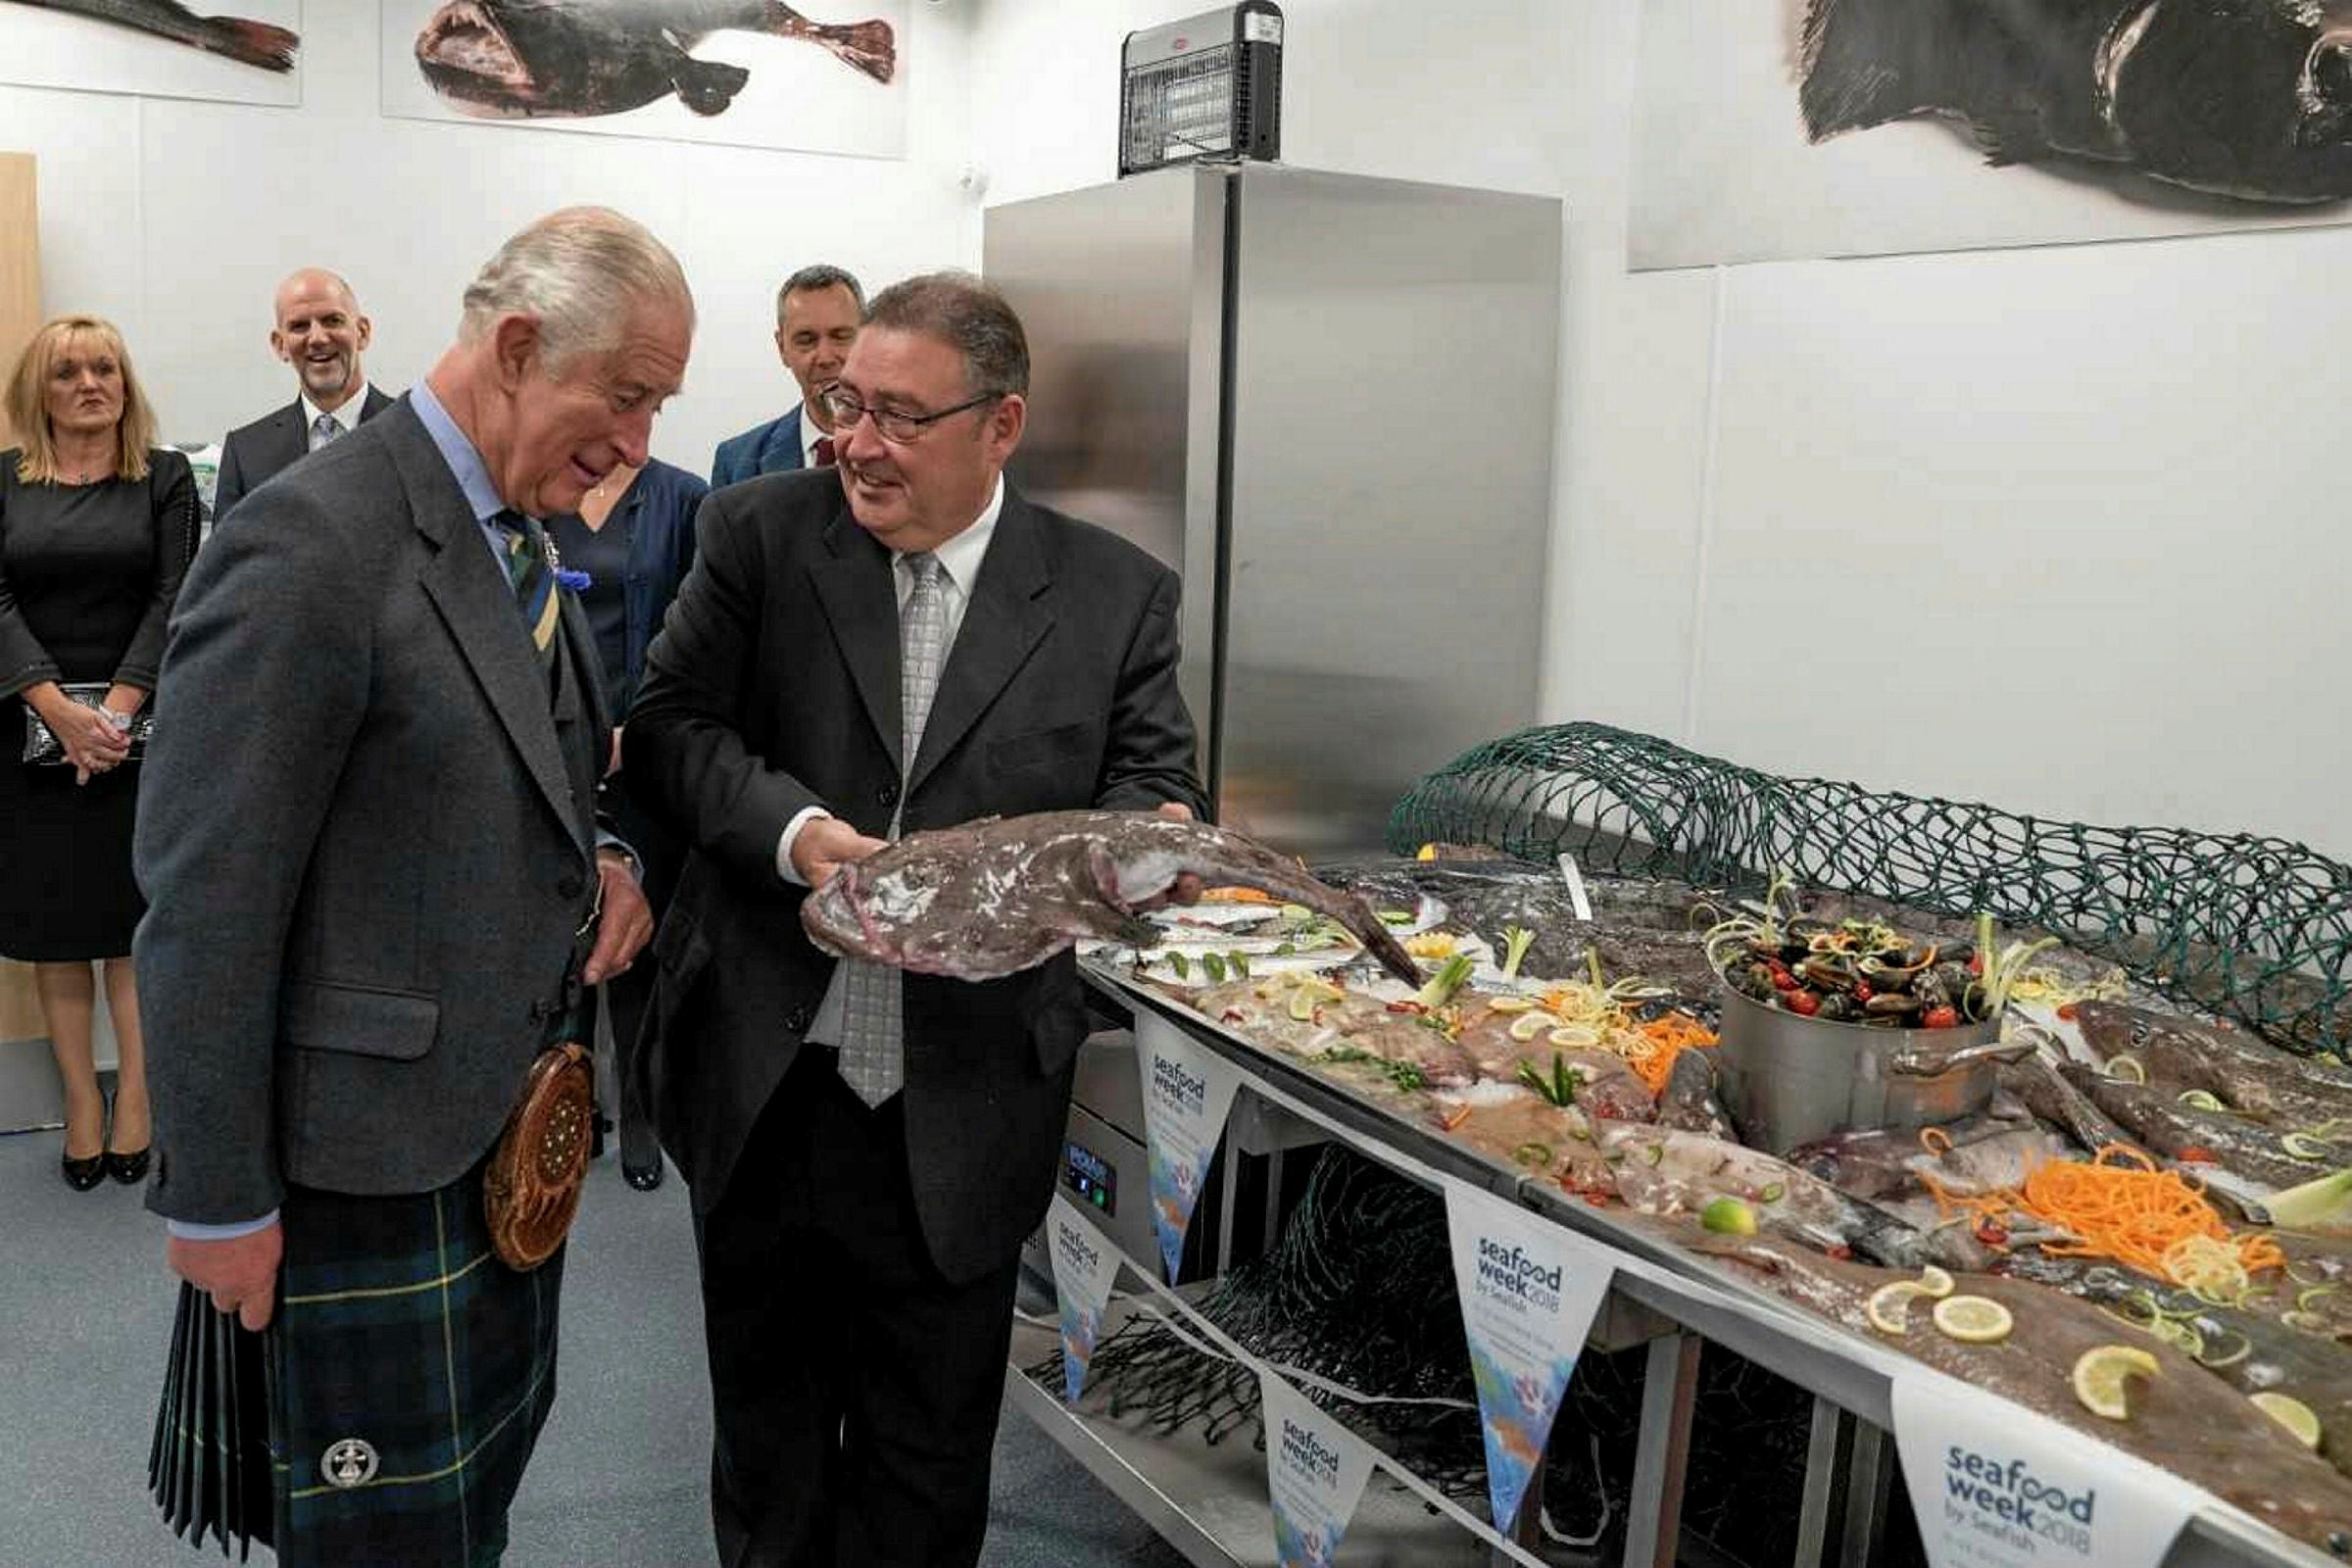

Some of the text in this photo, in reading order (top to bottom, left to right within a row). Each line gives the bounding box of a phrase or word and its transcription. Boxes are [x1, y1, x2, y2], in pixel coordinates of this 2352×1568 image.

[1154, 1053, 1205, 1100] seafood
[1479, 1237, 1563, 1293] seafood
[1283, 1419, 1339, 1472] seafood
[1946, 1446, 2095, 1525] seafood
